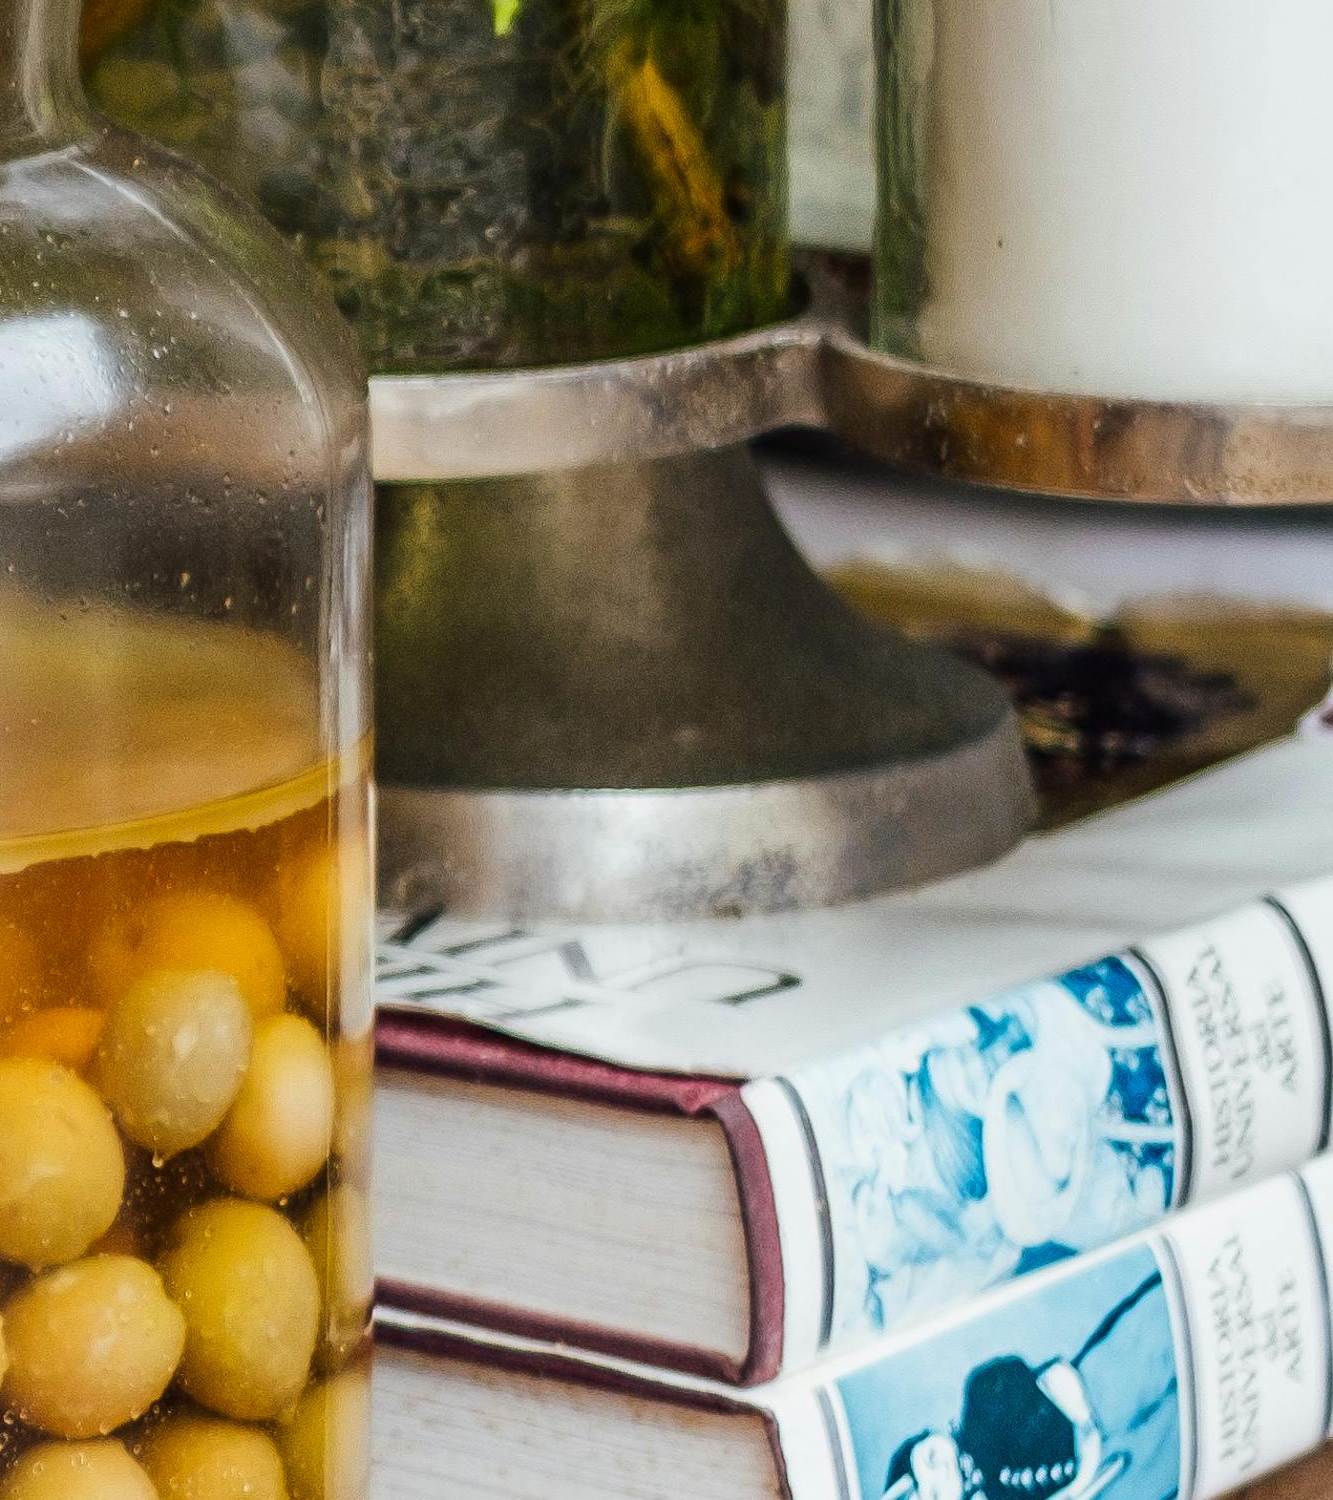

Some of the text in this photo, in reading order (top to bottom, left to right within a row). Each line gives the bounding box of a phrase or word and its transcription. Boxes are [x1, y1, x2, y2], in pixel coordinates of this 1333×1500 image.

[1186, 963, 1231, 1169] HISTORIA
[1197, 943, 1255, 1180] UNIVERSAL
[1263, 979, 1298, 1092] ARTE
[1205, 1255, 1238, 1463] HISTORIA
[1222, 1231, 1260, 1474] UNIVERSAL
[1276, 1269, 1303, 1382] ARTE
